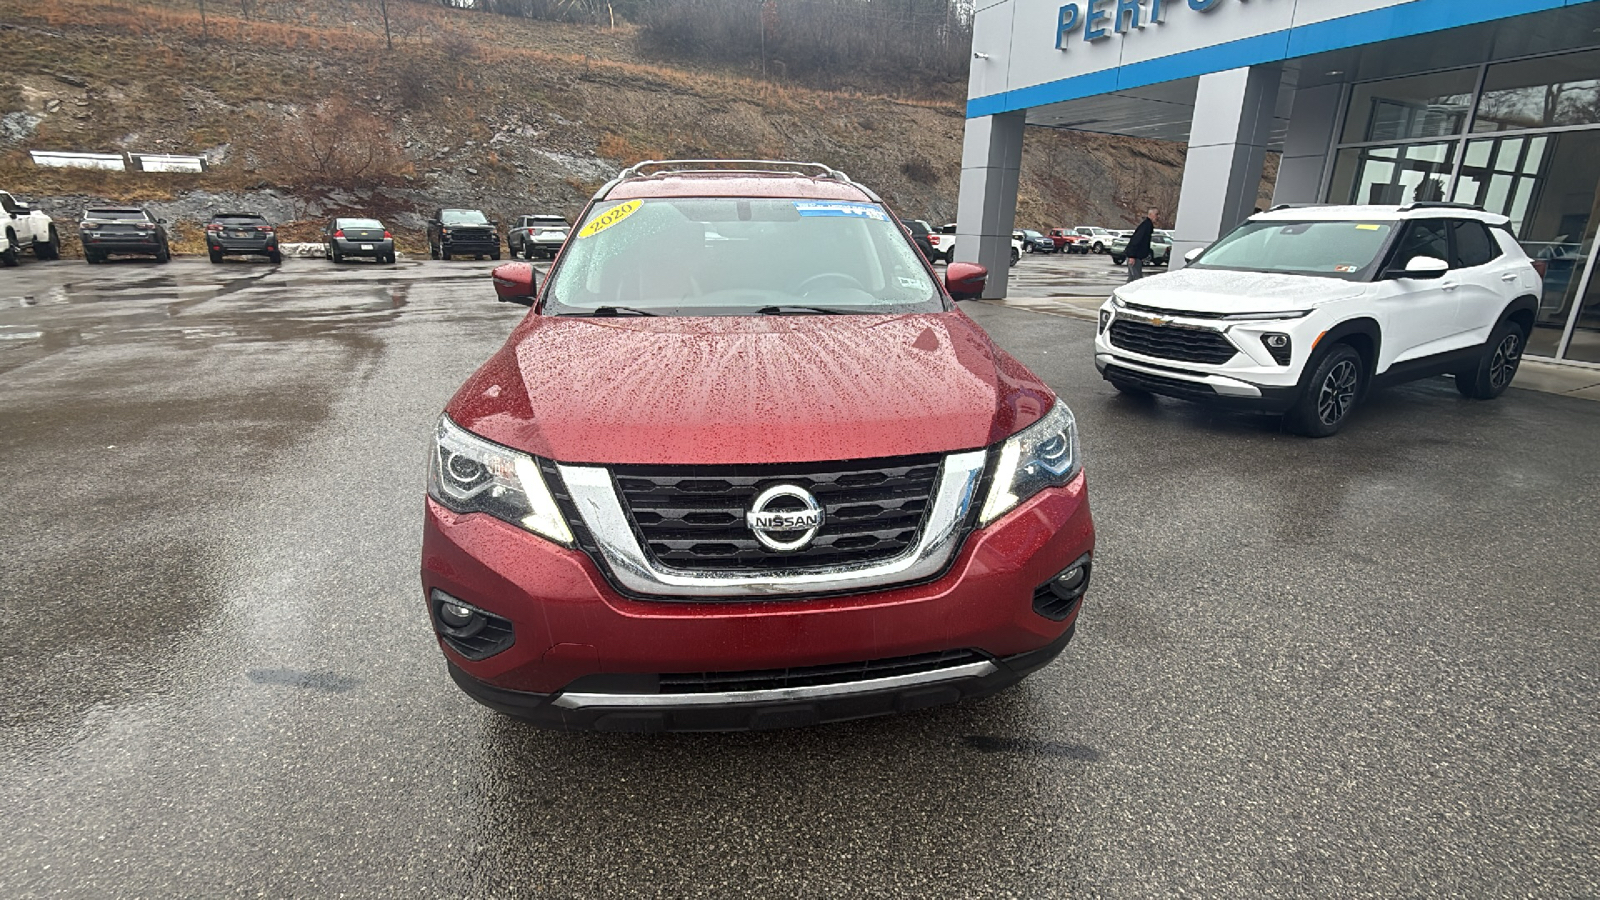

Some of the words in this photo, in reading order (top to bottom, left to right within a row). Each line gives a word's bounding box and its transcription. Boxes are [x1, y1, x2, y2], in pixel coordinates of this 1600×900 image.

[1055, 0, 1219, 50] PER
[590, 204, 633, 232] 2020
[755, 515, 818, 527] NISSAN
